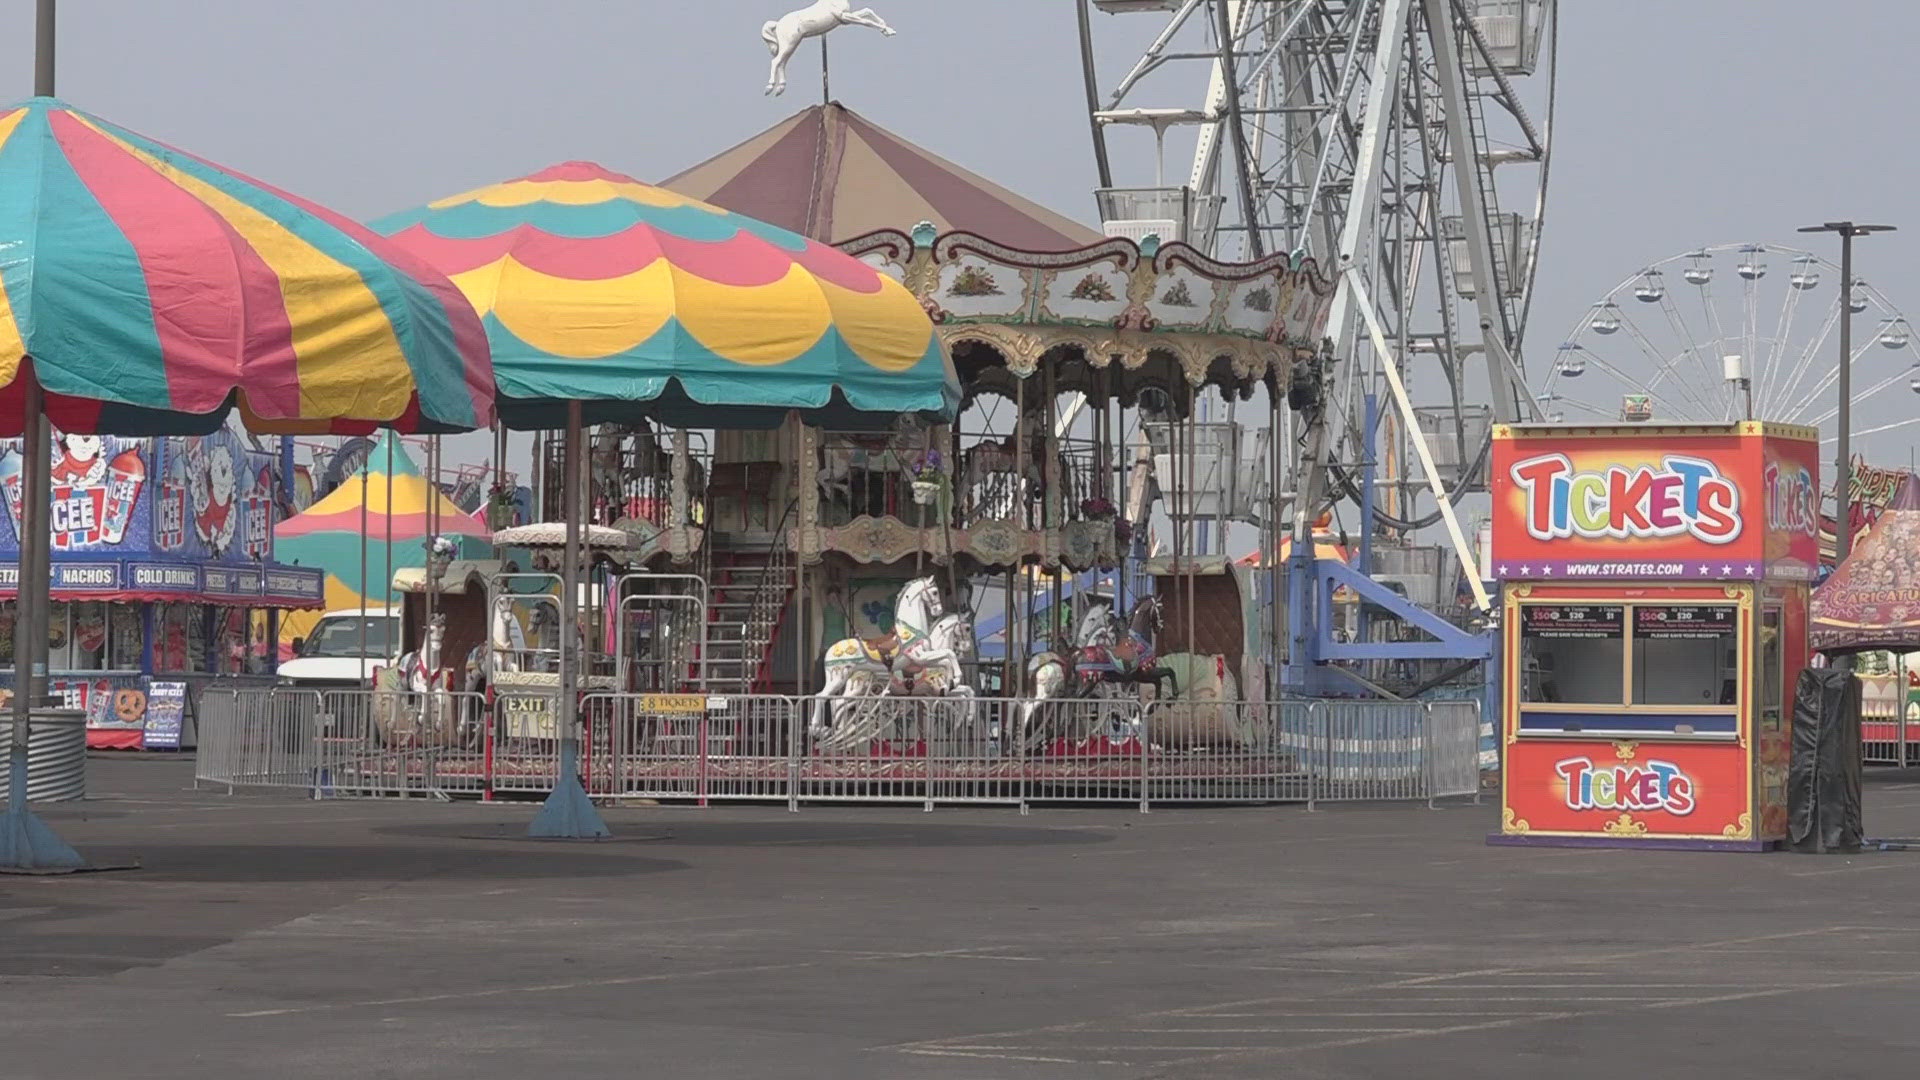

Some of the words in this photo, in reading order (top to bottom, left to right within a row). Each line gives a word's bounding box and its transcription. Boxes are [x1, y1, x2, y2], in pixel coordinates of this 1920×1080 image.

[107, 478, 136, 503] ICEE
[1511, 454, 1742, 544] TICKETS
[1765, 462, 1816, 537] TICKETS
[51, 497, 95, 533] CEE
[158, 498, 180, 534] ICEE
[245, 508, 268, 543] ICEE
[62, 568, 112, 584] NACHOS
[136, 568, 162, 584] COLD
[164, 569, 196, 586] DRINKS
[1566, 563, 1683, 576] WWW.STRATES.COM
[508, 697, 544, 711] EXIT
[648, 698, 656, 709] 8
[660, 697, 700, 708] TICKETS
[1557, 757, 1695, 815] TICKETS
